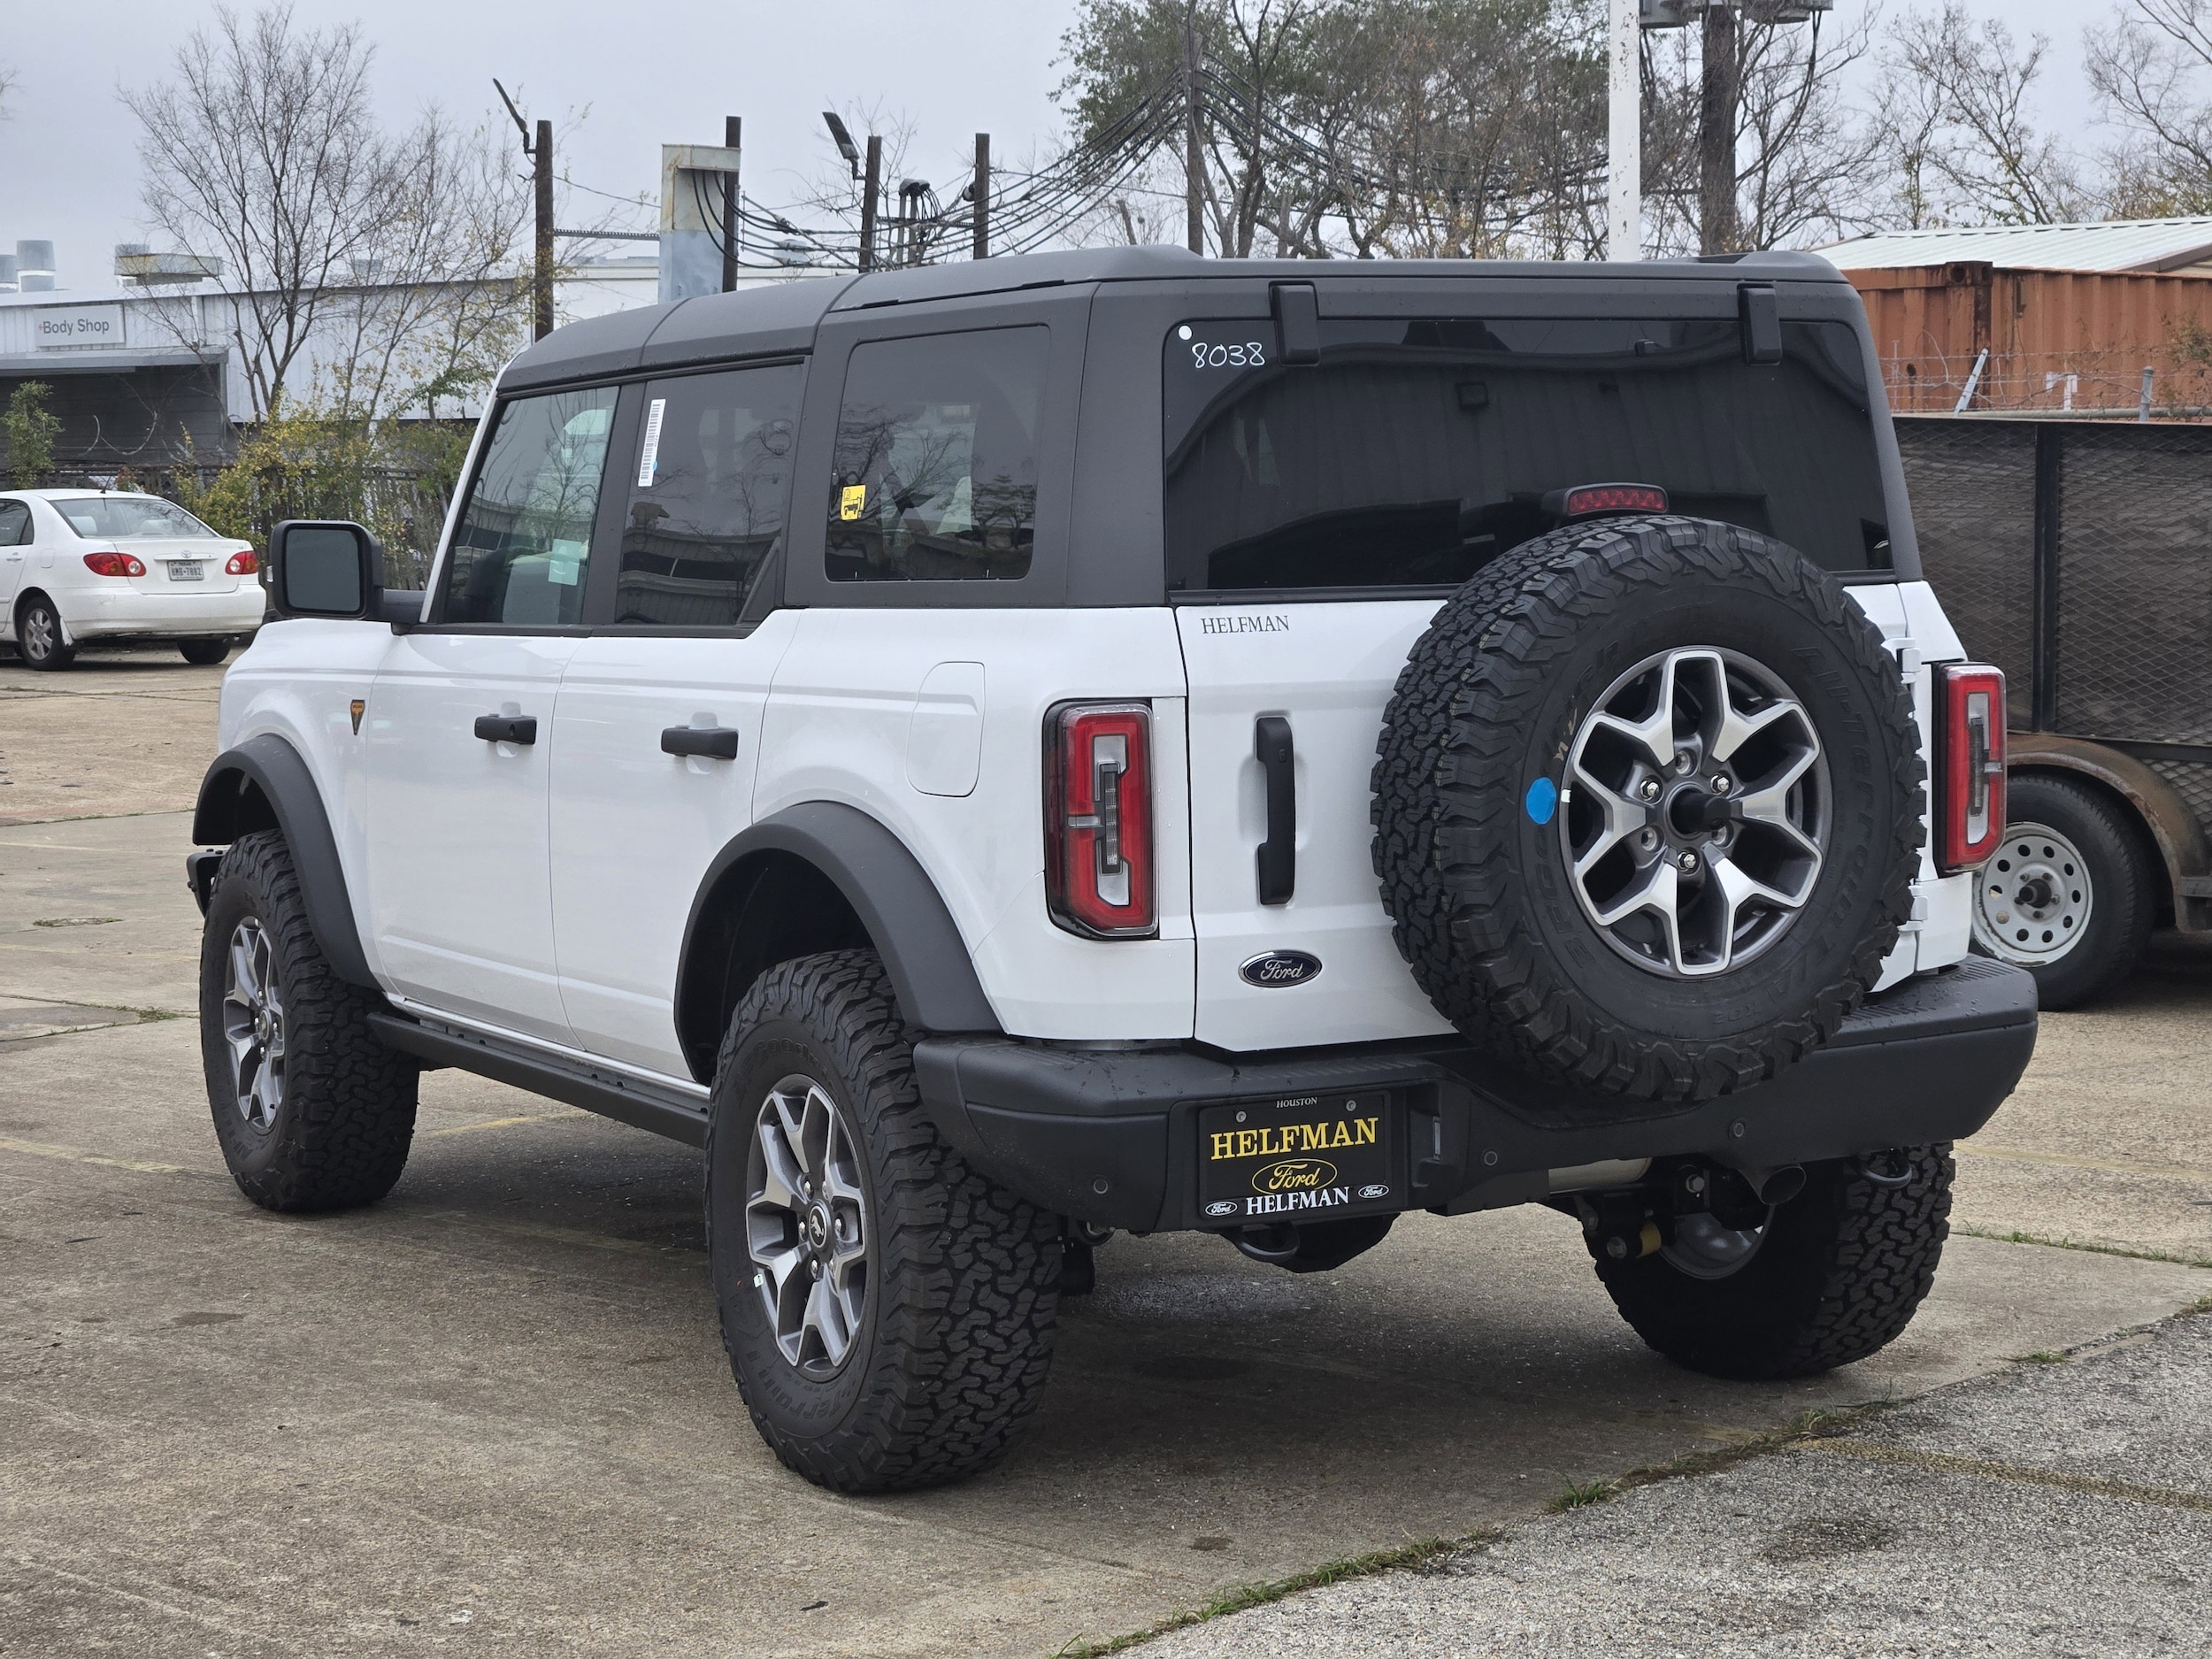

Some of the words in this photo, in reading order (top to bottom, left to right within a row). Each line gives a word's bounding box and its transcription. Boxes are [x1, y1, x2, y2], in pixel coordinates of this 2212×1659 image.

[42, 319, 73, 336] Body
[77, 319, 110, 334] Shop
[1192, 342, 1265, 369] 8038
[1201, 615, 1290, 634] HELFMAN
[1260, 958, 1304, 981] Ford
[1276, 1096, 1318, 1109] HOUSTON
[1210, 1117, 1379, 1161] HELFMAN
[1268, 1163, 1322, 1190] Ford
[1210, 1202, 1232, 1214] Ford
[1246, 1186, 1351, 1216] HELFMAN
[1363, 1185, 1384, 1196] Ford
